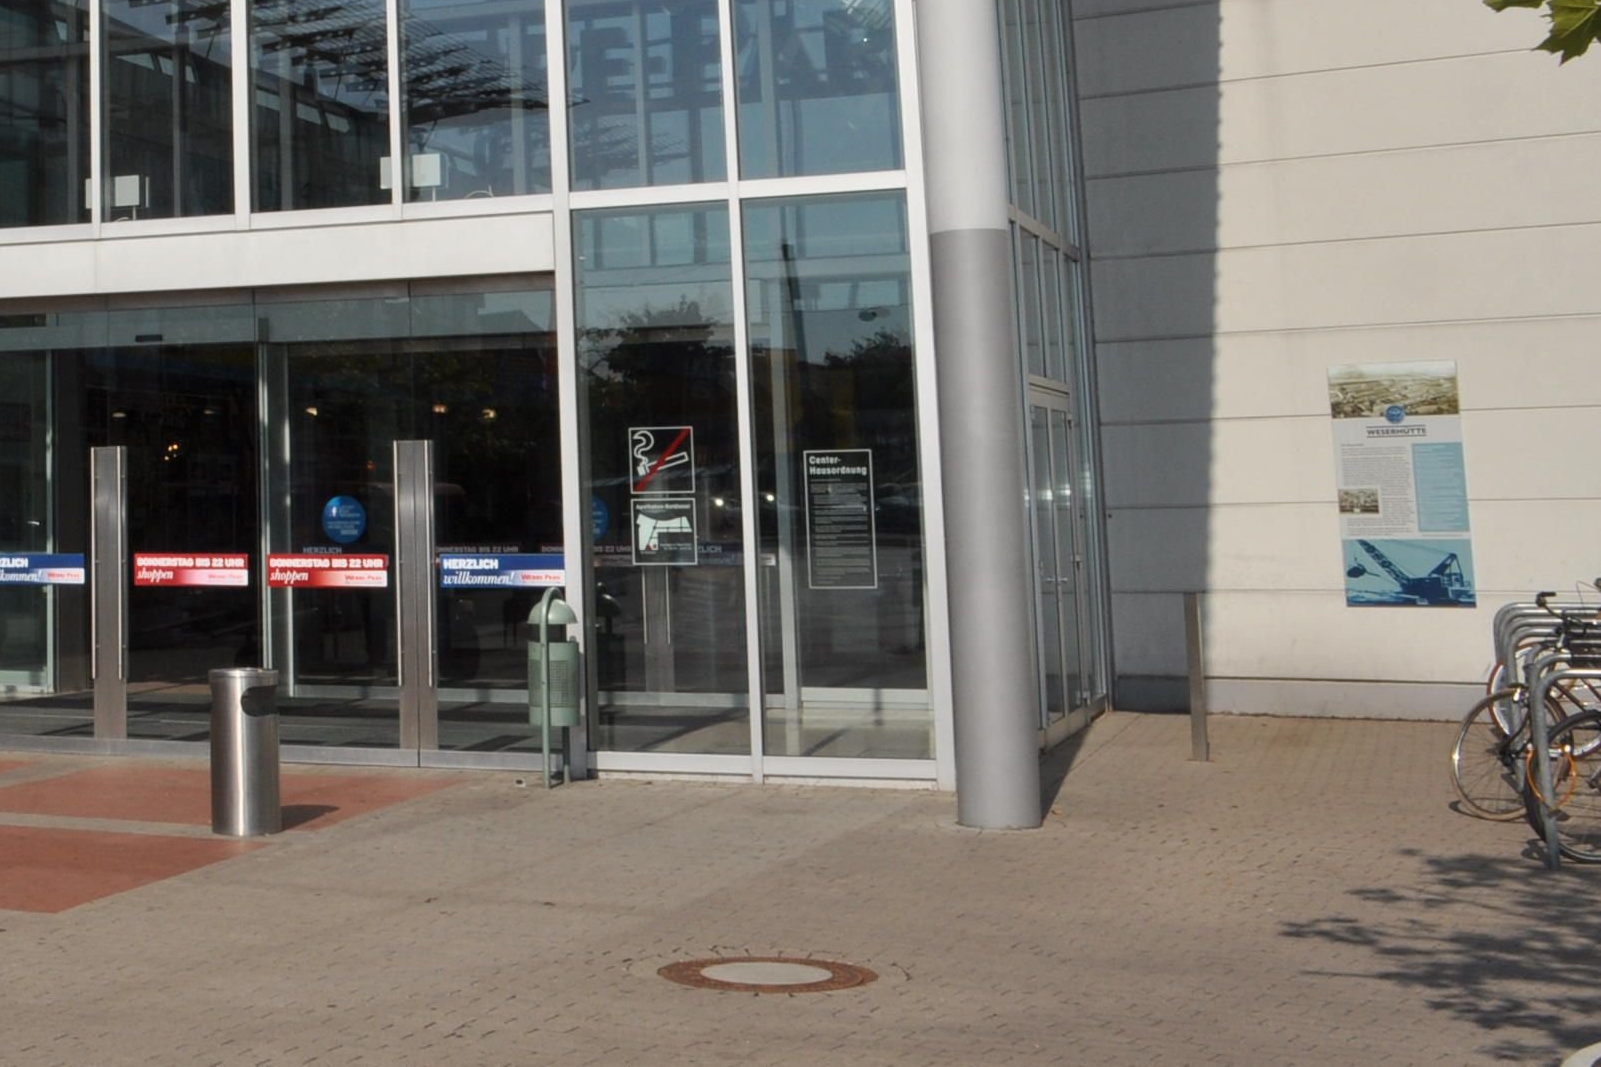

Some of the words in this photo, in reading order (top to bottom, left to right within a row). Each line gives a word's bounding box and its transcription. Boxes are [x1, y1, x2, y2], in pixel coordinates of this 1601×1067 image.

[269, 558, 330, 568] DONNERSTAG
[349, 558, 362, 568] 22
[363, 558, 384, 568] UHR
[442, 558, 499, 569] HERZLICH
[137, 567, 174, 583] shoppen
[269, 568, 310, 585] shoppen
[442, 570, 515, 585] willkommen!
